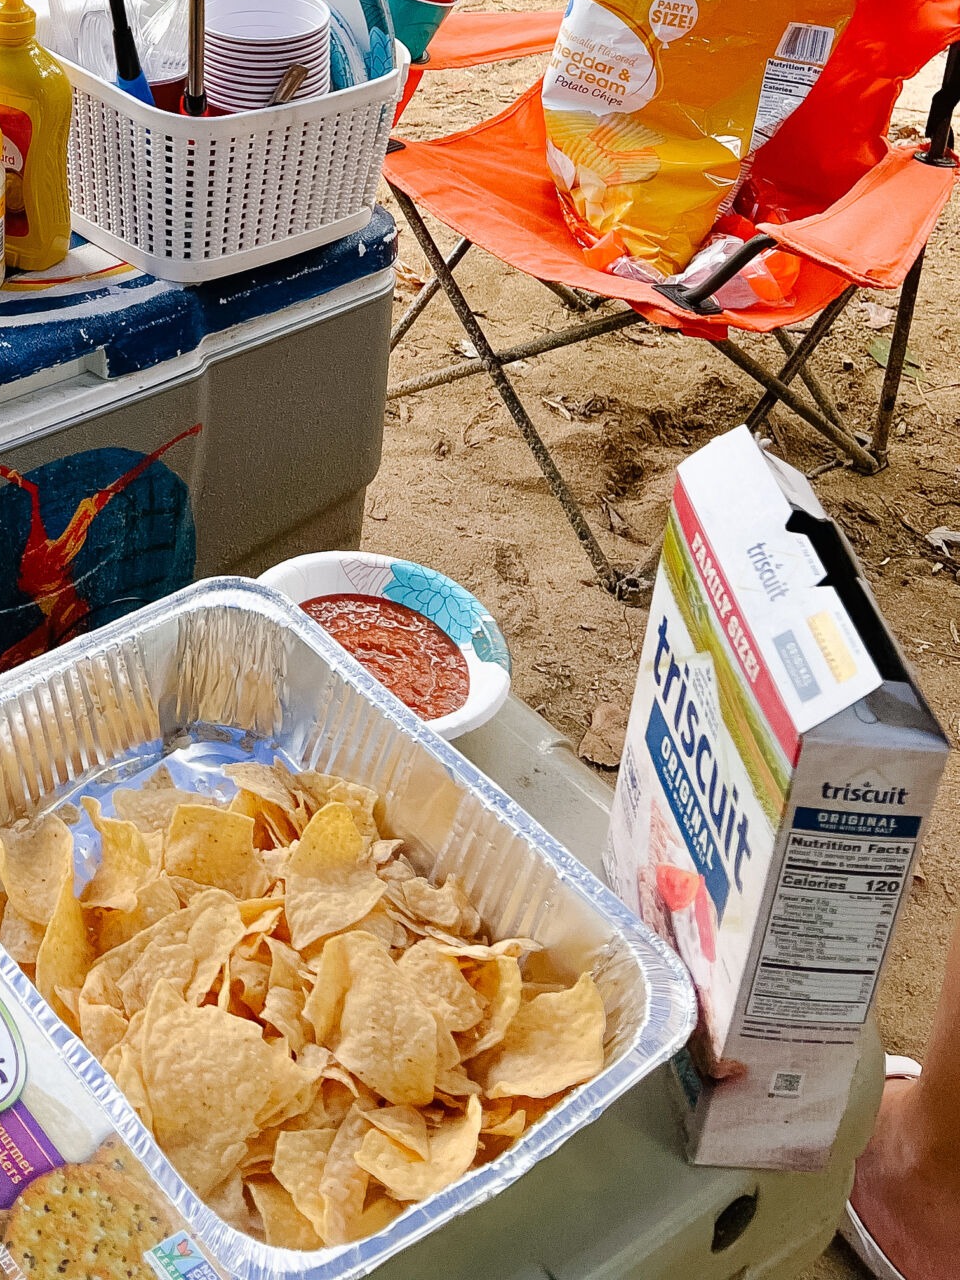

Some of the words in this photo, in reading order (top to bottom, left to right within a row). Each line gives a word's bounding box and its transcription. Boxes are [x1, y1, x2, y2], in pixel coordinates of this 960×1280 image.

[657, 0, 694, 14] PARTY
[651, 9, 694, 29] SIZE!
[618, 68, 631, 83] &
[768, 60, 805, 72] Nutrition
[565, 63, 626, 96] Cream
[763, 84, 793, 93] Calories
[554, 74, 589, 94] Potato
[591, 88, 623, 106] Chips
[691, 531, 732, 618] FAMILY
[746, 541, 790, 602] triscuit
[653, 614, 752, 895] triscuit
[661, 735, 713, 870] ORIGINAL
[821, 782, 909, 806] triscuit
[817, 812, 898, 828] ORIGINAL
[791, 837, 861, 852] Nutrition
[868, 843, 910, 855] Facts
[782, 875, 847, 890] Calories
[865, 880, 900, 893] 120
